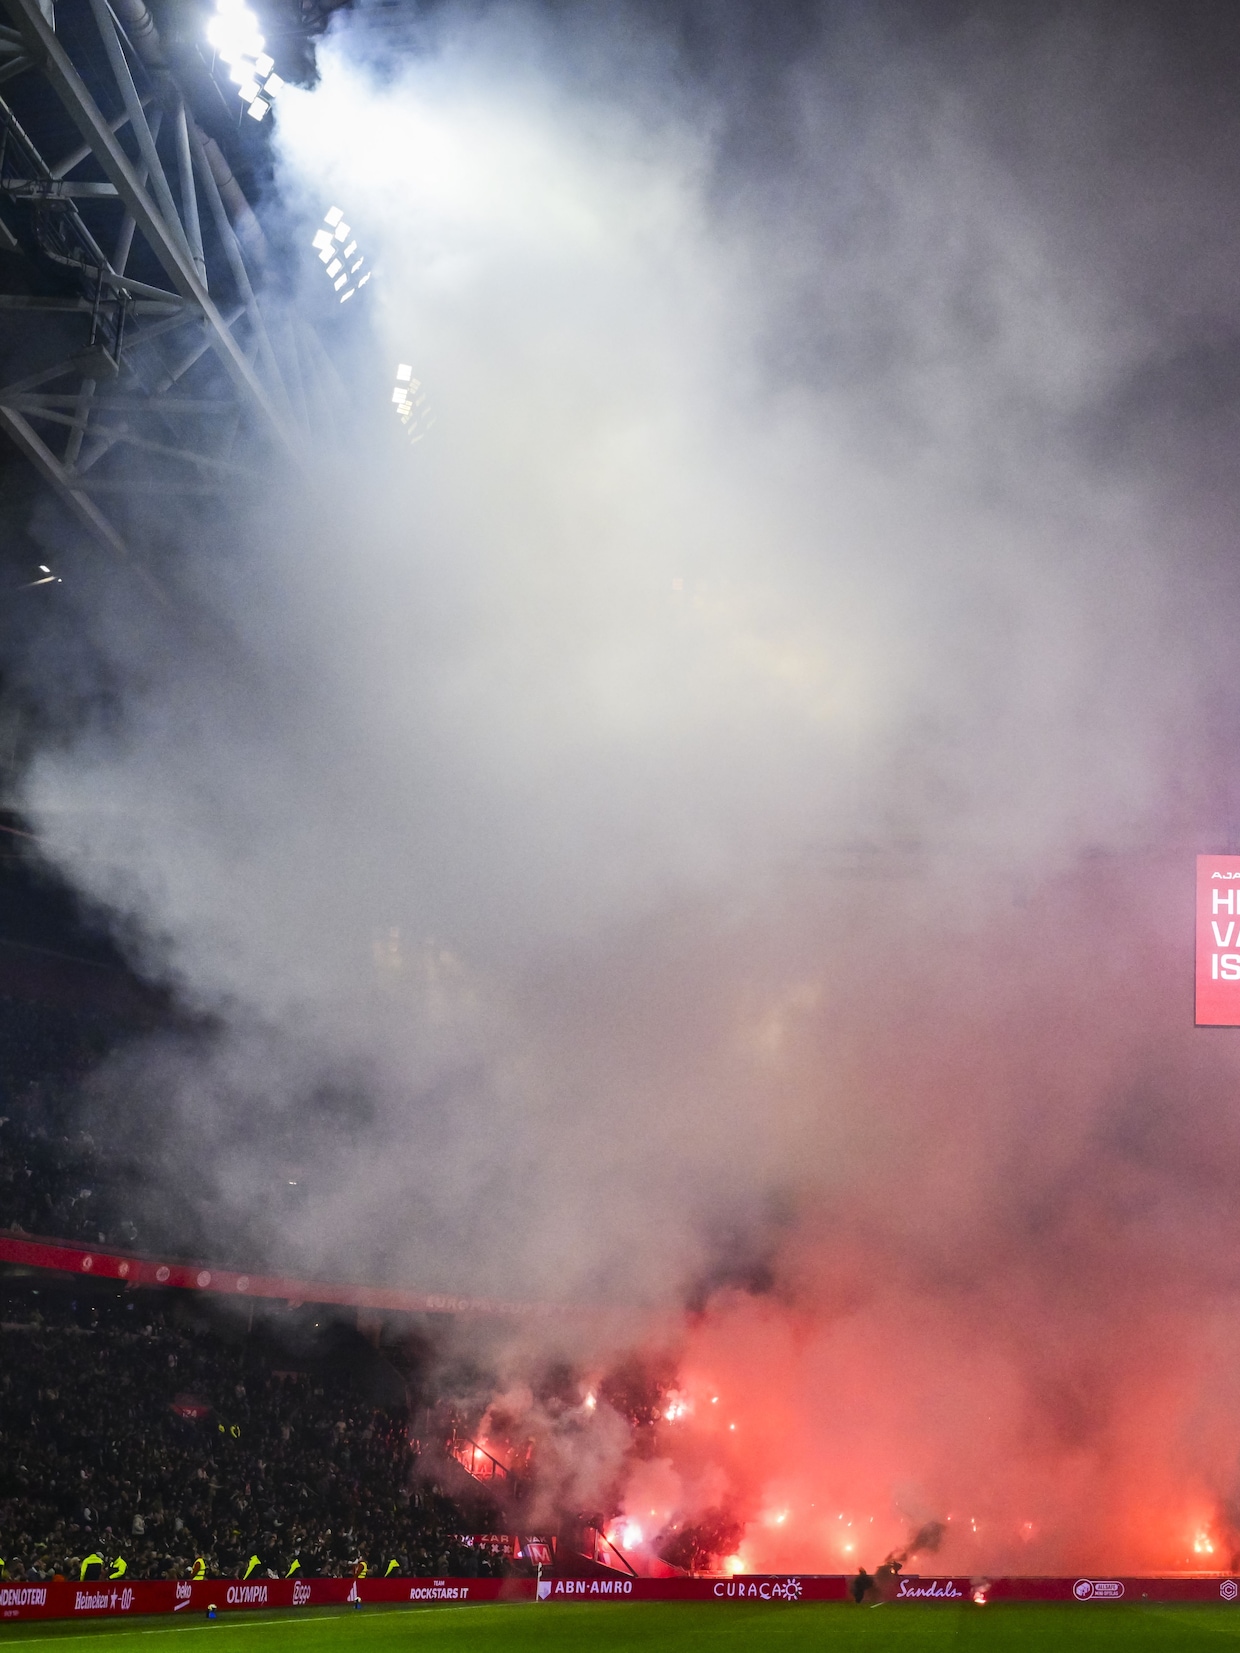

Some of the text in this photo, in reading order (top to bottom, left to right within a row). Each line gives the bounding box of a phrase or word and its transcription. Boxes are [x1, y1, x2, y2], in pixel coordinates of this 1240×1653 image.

[176, 1581, 192, 1599] beko
[227, 1585, 268, 1604] OLYMPIA
[410, 1587, 469, 1600] ROCKSTARS IT
[897, 1579, 963, 1597] Sandals
[74, 1590, 109, 1610] Heineken
